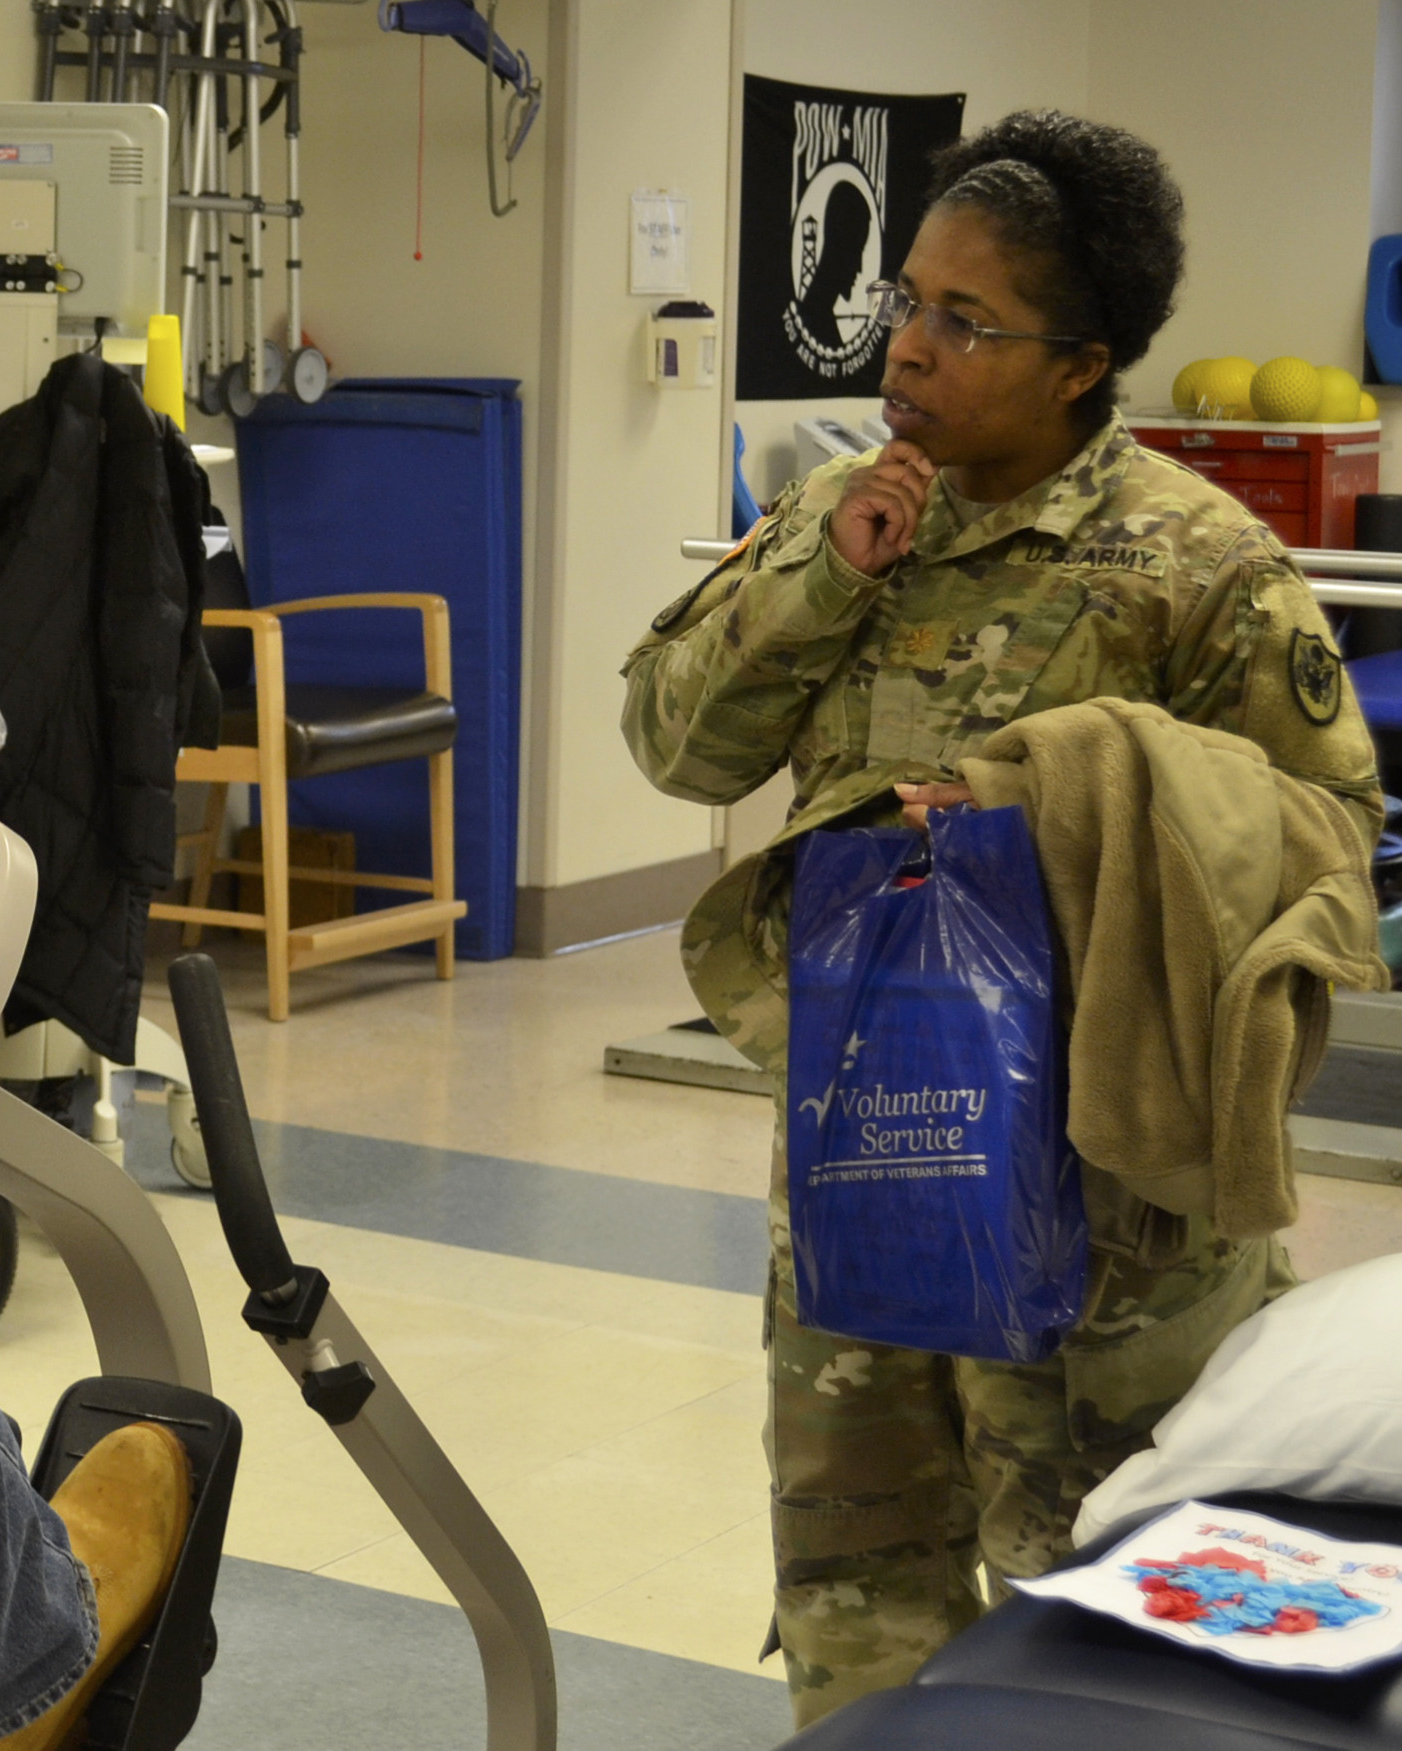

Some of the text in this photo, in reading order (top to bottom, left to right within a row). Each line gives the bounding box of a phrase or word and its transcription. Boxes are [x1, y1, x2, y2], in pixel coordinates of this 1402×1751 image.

[791, 101, 889, 233] POW MIA
[818, 361, 838, 378] NOT
[841, 322, 885, 378] FORGOTTE
[1079, 546, 1157, 571] ARMY
[837, 1084, 986, 1122] Voluntary
[860, 1117, 963, 1155] Service
[807, 1164, 988, 1187] EPARTMENT OF VETERANS AFFAIRS
[1195, 1522, 1402, 1584] THANK YO
